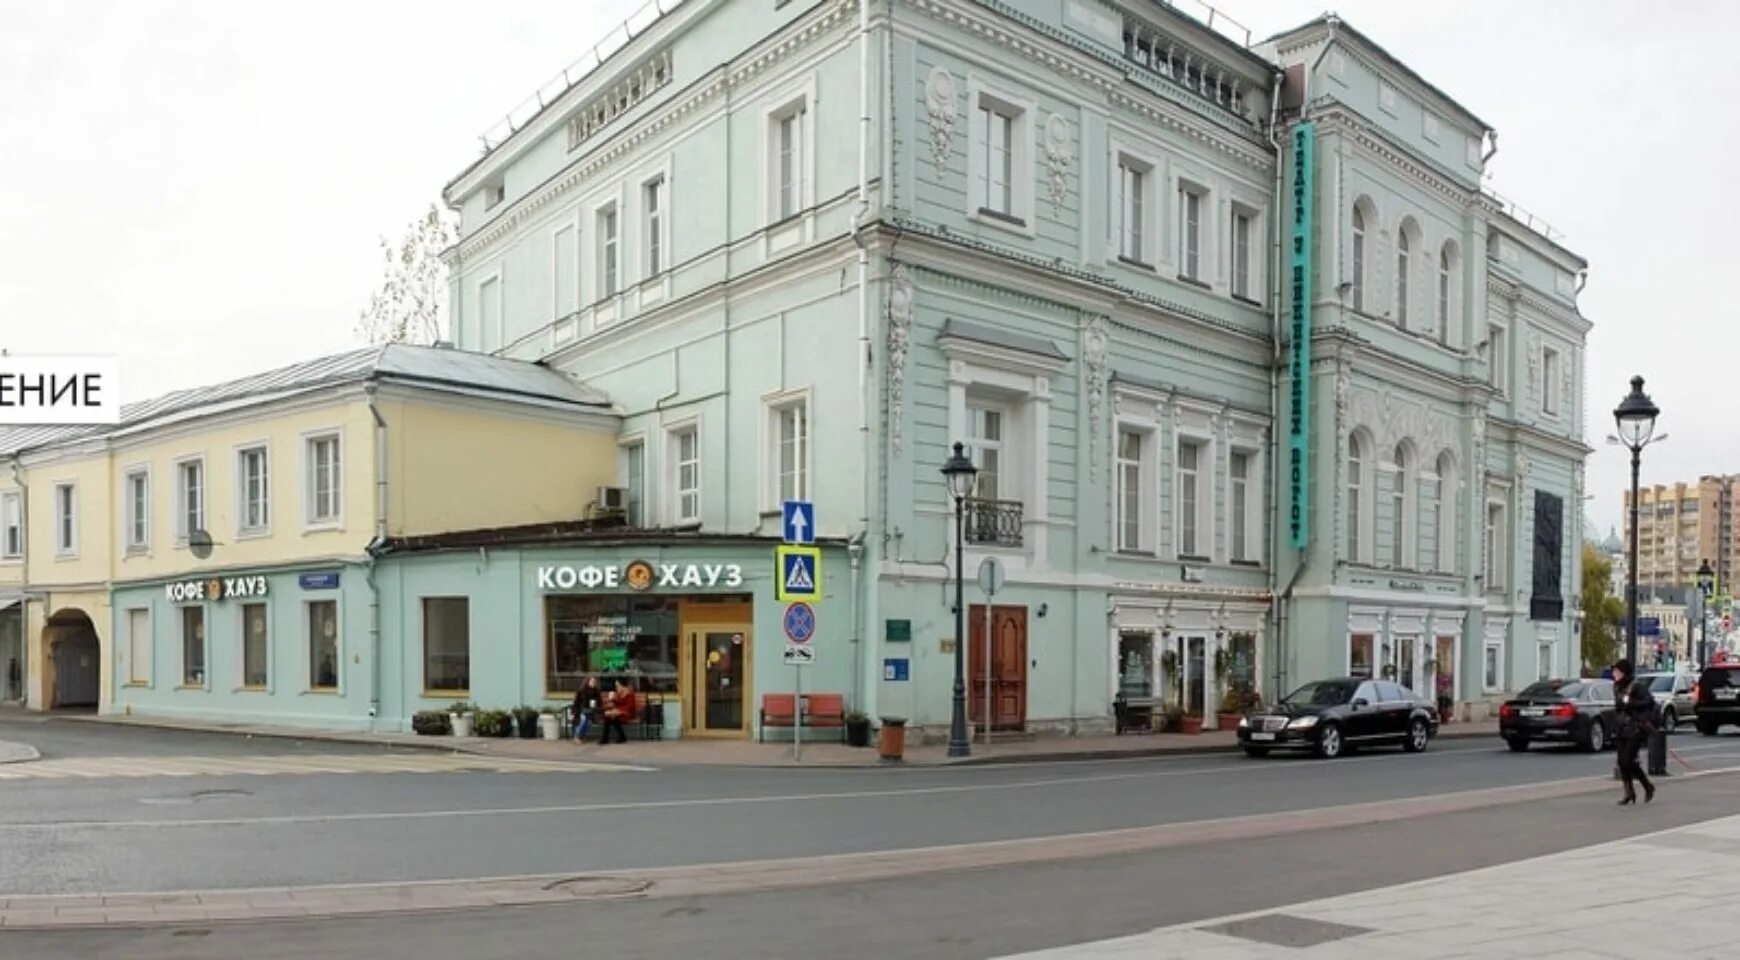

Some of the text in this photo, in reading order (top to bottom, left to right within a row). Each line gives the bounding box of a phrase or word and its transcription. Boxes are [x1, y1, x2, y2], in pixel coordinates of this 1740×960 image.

[1294, 130, 1305, 225] ТЕАТР
[1294, 236, 1304, 255] У
[1291, 447, 1301, 540] ВОРОТ
[537, 563, 743, 588] КОФЕ ХАУЗ
[165, 576, 267, 601] КОФЕ ХАУЗ
